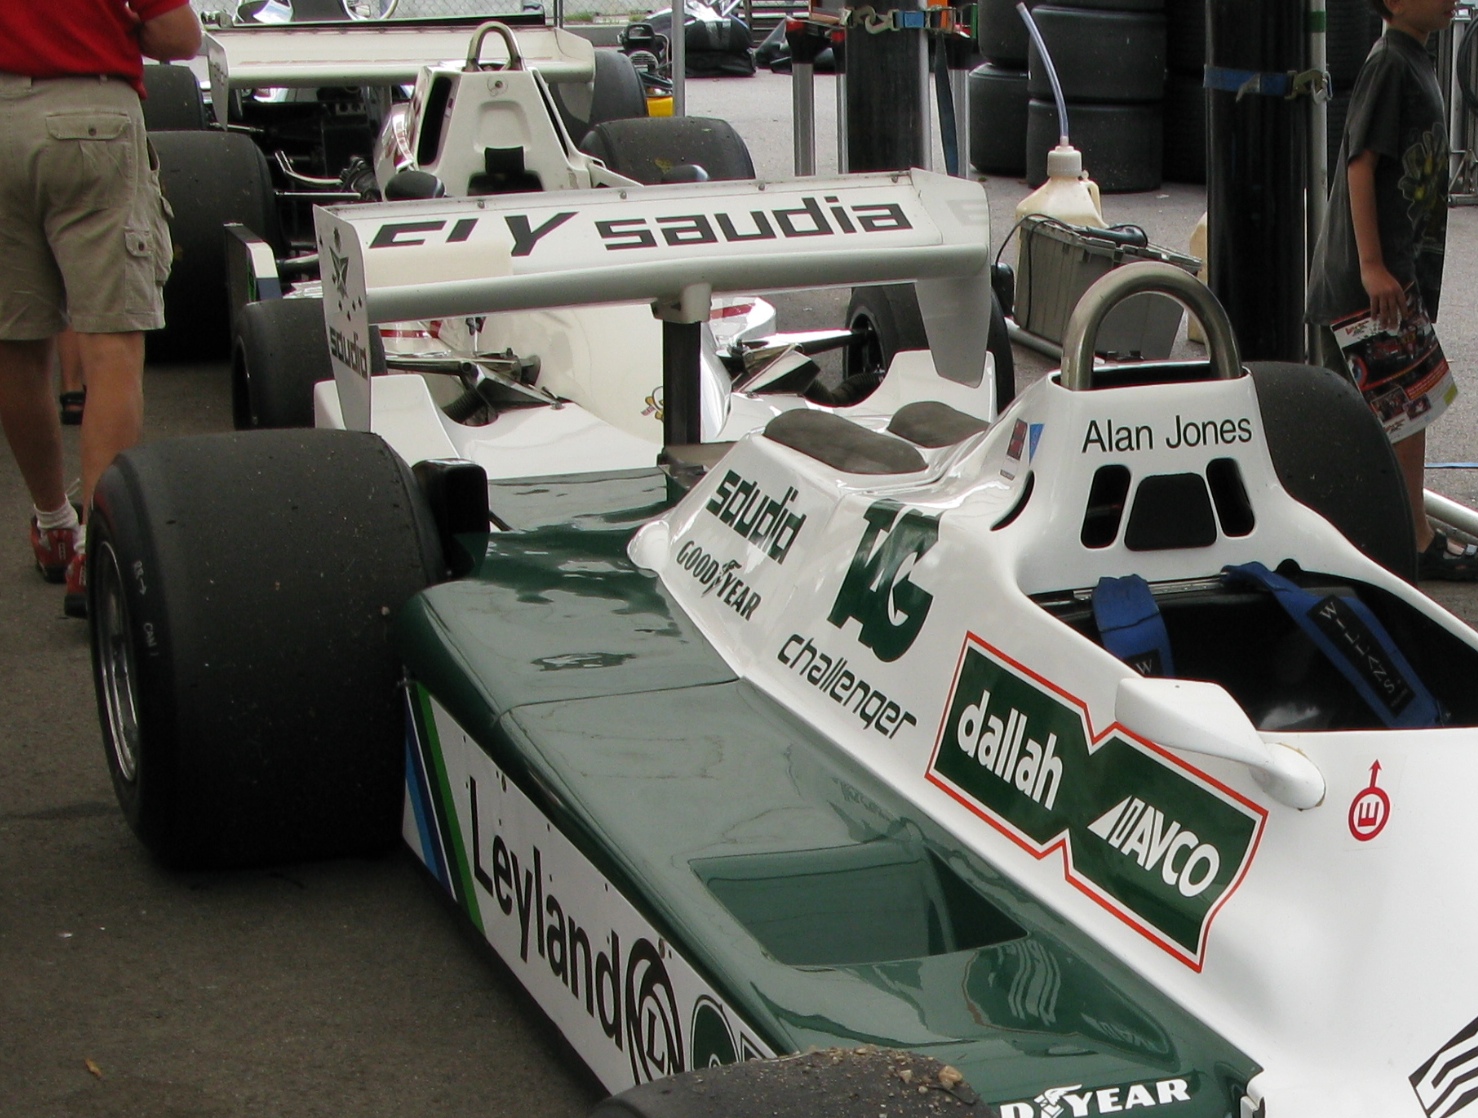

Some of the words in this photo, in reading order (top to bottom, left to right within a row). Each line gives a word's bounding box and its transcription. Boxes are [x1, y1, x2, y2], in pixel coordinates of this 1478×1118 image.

[596, 196, 914, 251] saudia
[329, 326, 368, 380] saudia
[1081, 419, 1154, 453] Alan
[1165, 415, 1252, 449] Jones
[705, 469, 807, 565] saudia
[827, 499, 942, 663] TAG
[777, 633, 917, 739] challenger
[1319, 601, 1395, 695] WILLANS
[955, 689, 1064, 811] dallah
[469, 775, 624, 1052] Leyland
